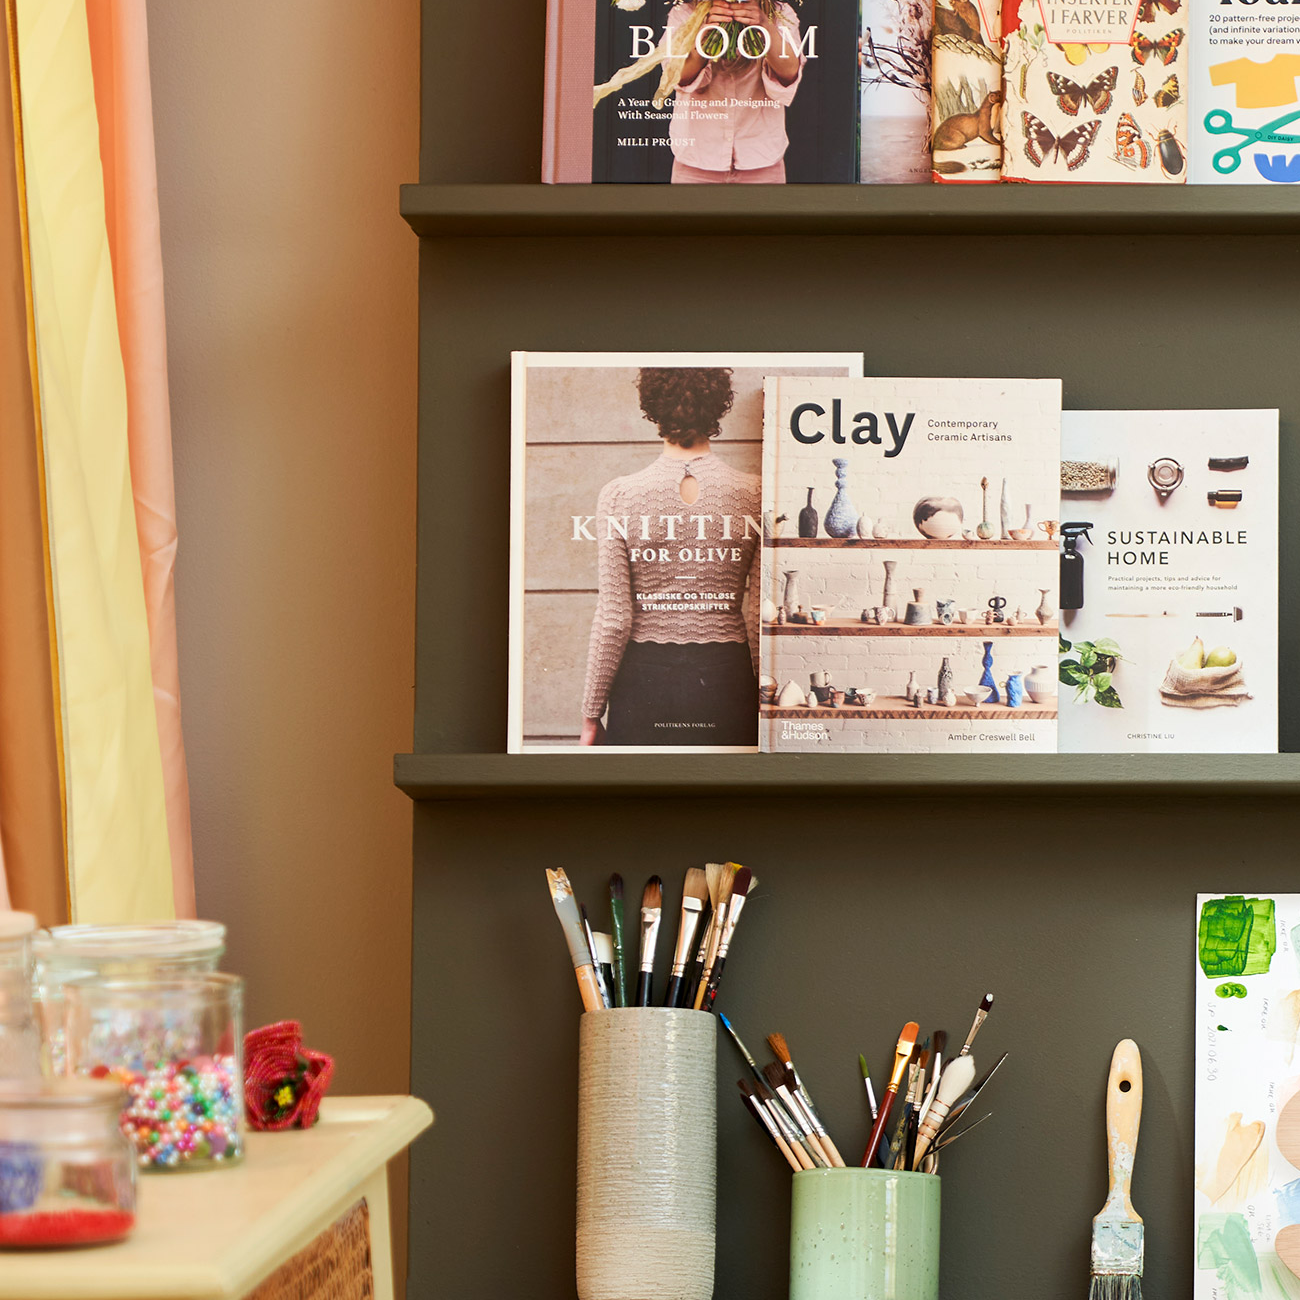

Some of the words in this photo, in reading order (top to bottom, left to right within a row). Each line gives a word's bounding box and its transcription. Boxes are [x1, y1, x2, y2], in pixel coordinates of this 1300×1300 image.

[1050, 9, 1056, 24] I
[1061, 9, 1129, 25] FARVER
[1209, 14, 1221, 23] 20
[1222, 13, 1276, 24] pattern-free
[1208, 26, 1229, 36] (and
[1230, 26, 1261, 34] infinite
[628, 24, 819, 60] BLOOM
[1220, 37, 1244, 45] make
[1245, 38, 1264, 46] your
[1266, 37, 1295, 45] dream
[617, 98, 626, 108] A
[627, 98, 650, 108] Year
[651, 97, 662, 108] of
[664, 98, 708, 110] Growing
[708, 98, 728, 108] and
[730, 98, 780, 110] Designing
[618, 110, 642, 120] With
[644, 110, 688, 120] Seasonal
[690, 110, 729, 120] Flowers
[617, 138, 649, 147] MILLI
[652, 138, 696, 147] PROUST
[789, 398, 916, 459] Clay
[927, 419, 998, 430] Contemporary
[927, 432, 968, 442] Ceramic
[970, 432, 1012, 442] Artisans
[570, 515, 762, 541] KNITTIN
[1107, 530, 1248, 545] SUSTAINABLE
[630, 548, 672, 562] FOR
[678, 548, 743, 562] OLIVE
[1107, 551, 1169, 565] HOME
[1136, 576, 1163, 584] projects,
[1108, 584, 1144, 592] maintaining
[1168, 584, 1204, 592] eco-friendly
[636, 592, 682, 600] KLASSISKE
[684, 592, 698, 600] OG
[699, 592, 736, 600] TIDLØSE
[642, 603, 730, 611] STRIKKEOPSKRIFTER
[781, 720, 824, 731] Thames
[781, 730, 829, 740] &Hudson
[948, 733, 977, 742] Amber
[978, 733, 1017, 742] Creswell
[1018, 733, 1036, 742] Bell
